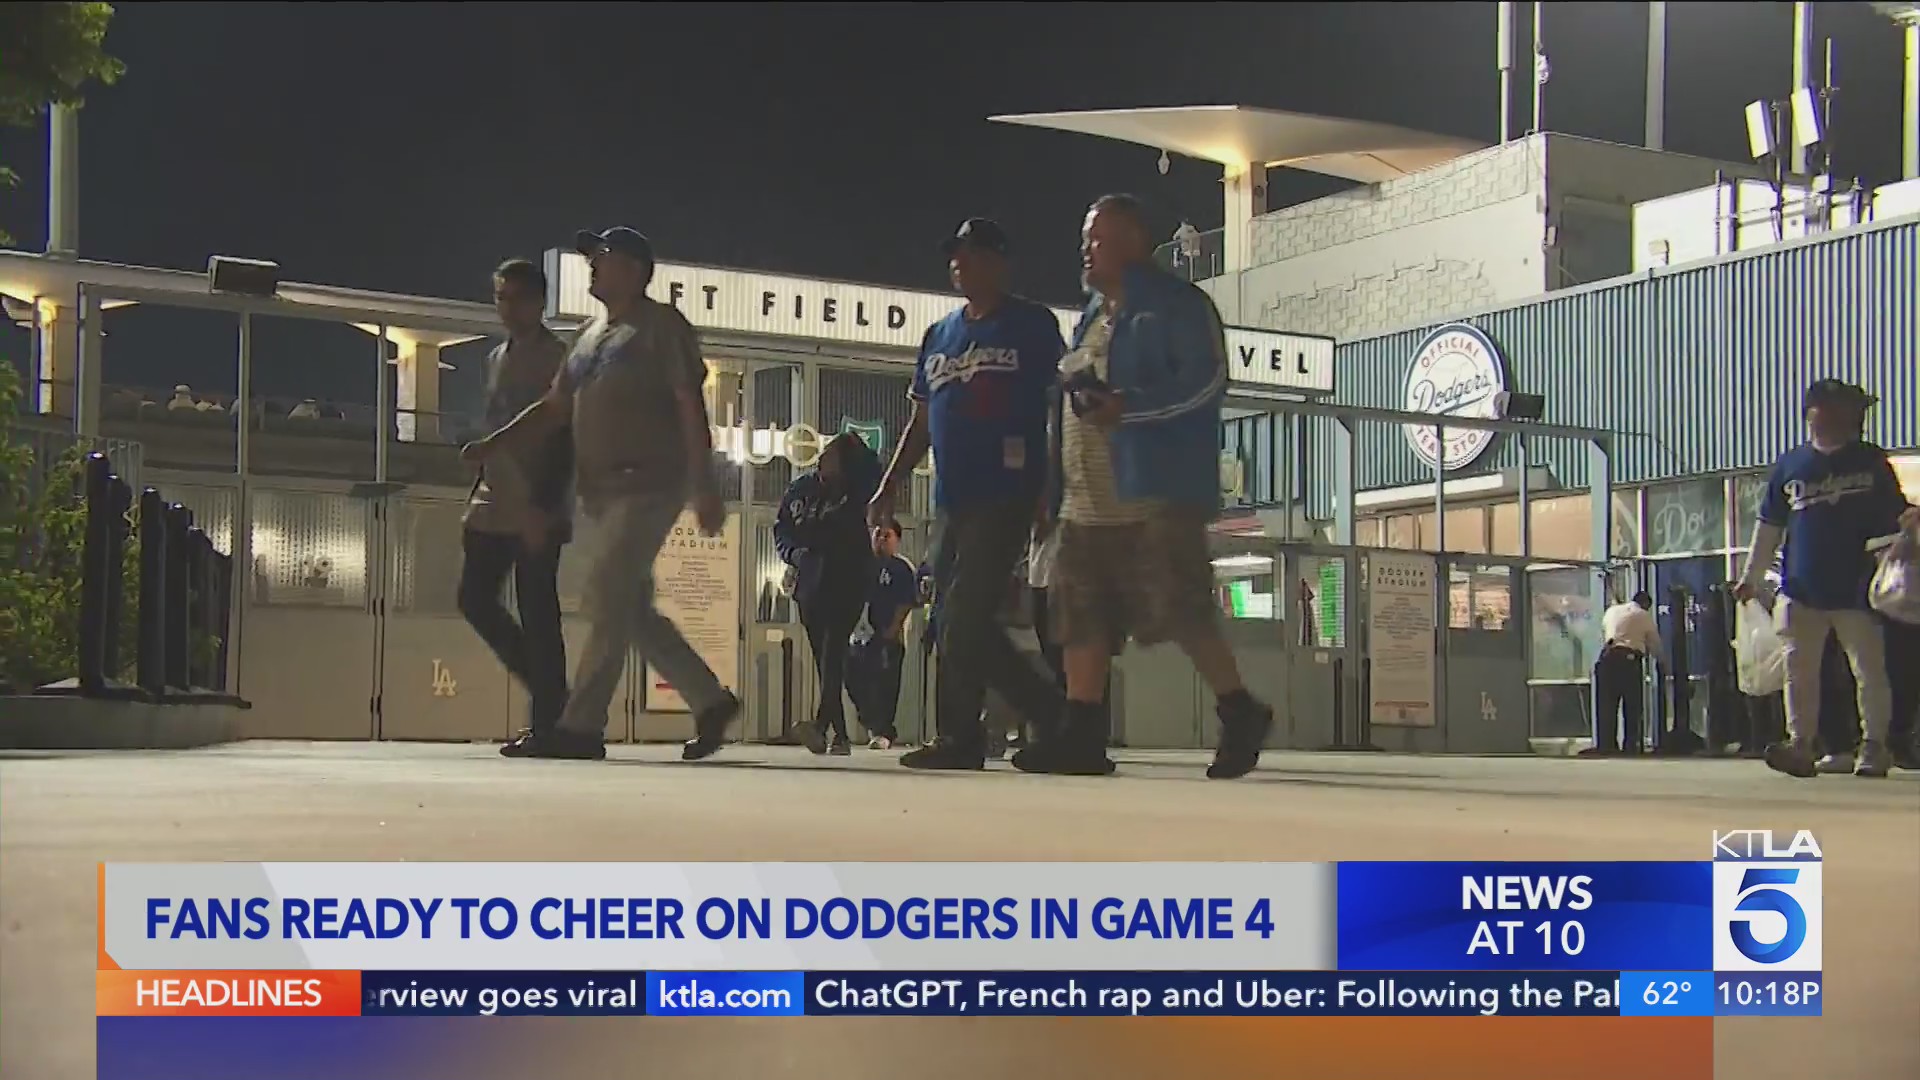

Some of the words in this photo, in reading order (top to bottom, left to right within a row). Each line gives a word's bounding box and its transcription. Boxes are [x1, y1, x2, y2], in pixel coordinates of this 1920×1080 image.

[669, 281, 719, 311] FT
[762, 291, 907, 329] FIELD
[1238, 344, 1309, 375] VEL
[1420, 336, 1480, 368] OFFICIAL
[1413, 370, 1492, 415] Dodgers
[670, 539, 728, 550] TADIUM
[432, 658, 457, 697] LA
